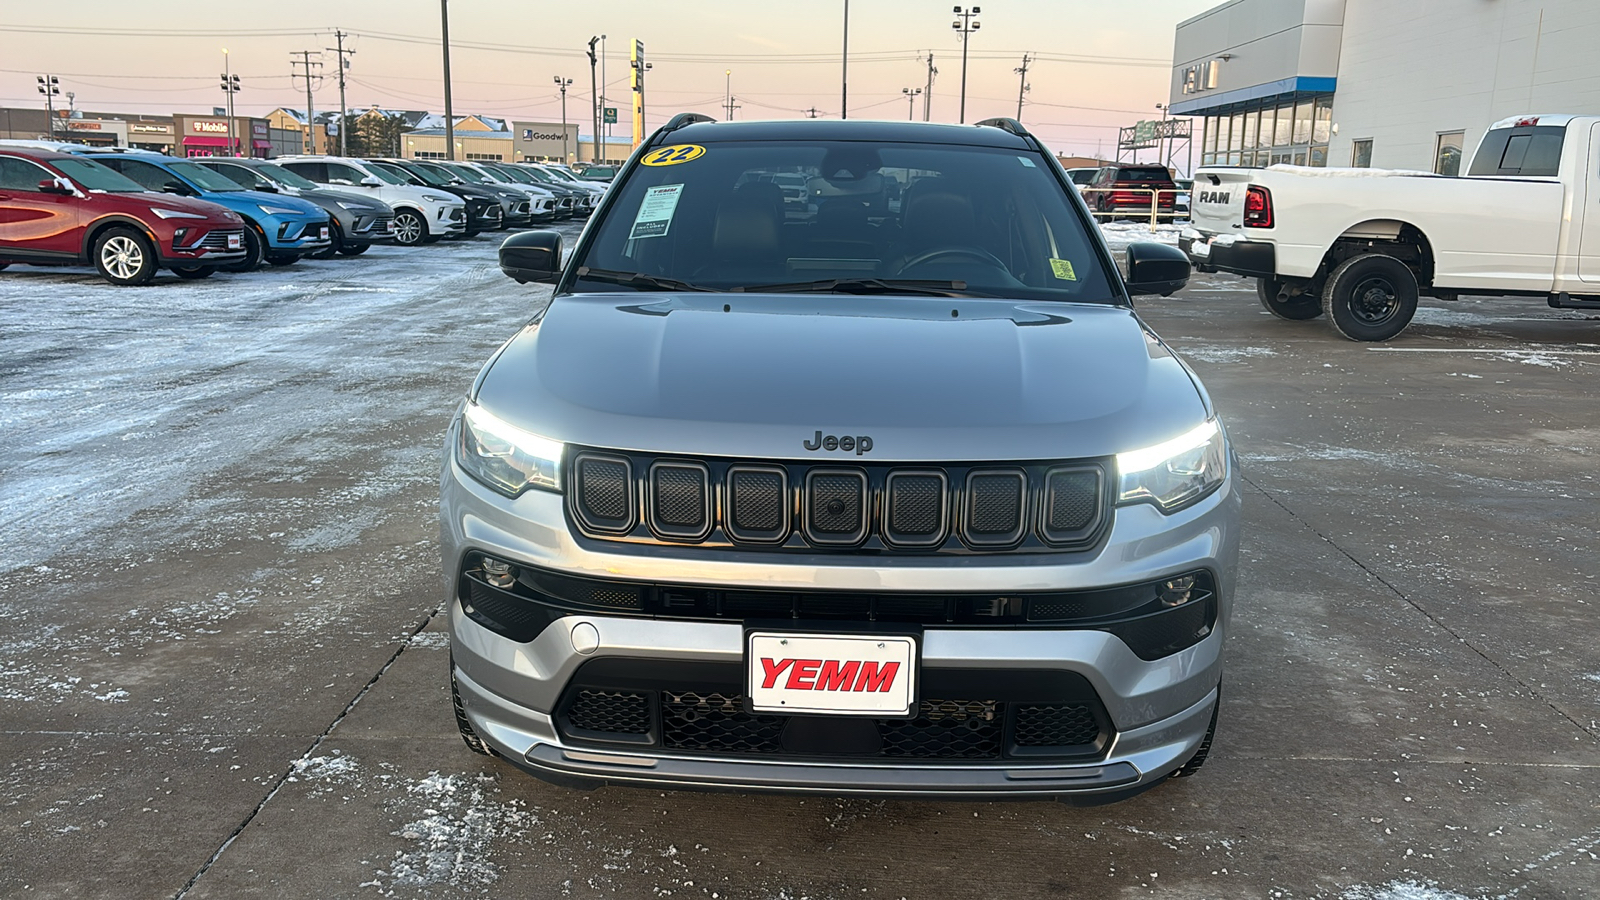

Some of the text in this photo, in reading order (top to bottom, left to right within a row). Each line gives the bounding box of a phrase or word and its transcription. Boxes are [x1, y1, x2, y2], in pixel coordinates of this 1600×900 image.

[533, 132, 569, 141] Goodwl
[651, 146, 695, 164] 22
[1199, 190, 1231, 205] RAM
[803, 430, 874, 456] Jeep
[760, 657, 902, 693] YEMM
